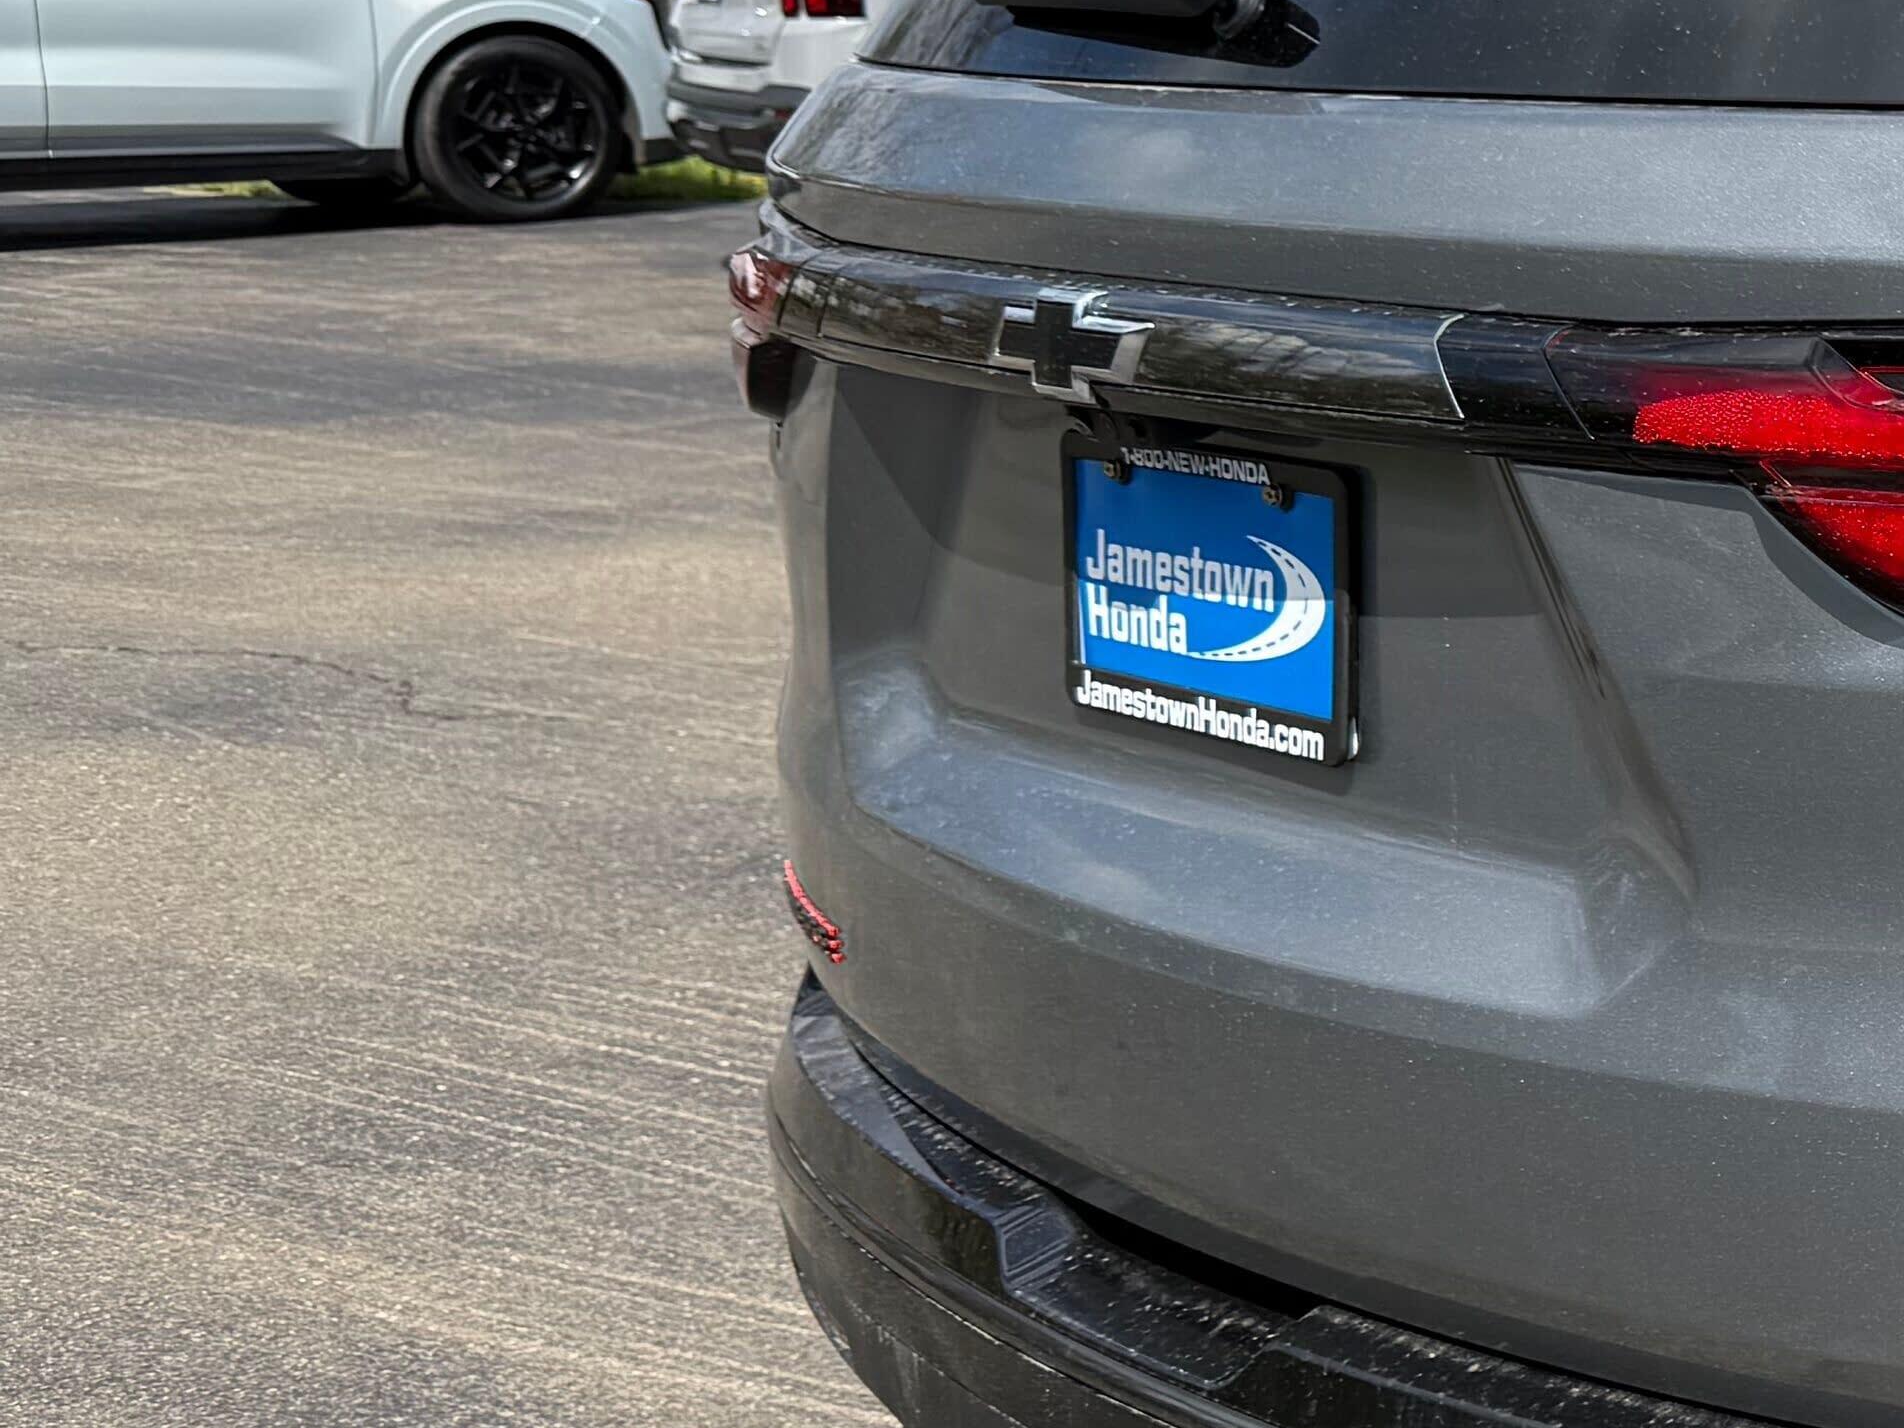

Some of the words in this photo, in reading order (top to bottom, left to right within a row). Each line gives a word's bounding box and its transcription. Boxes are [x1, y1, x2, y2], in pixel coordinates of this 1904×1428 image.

[1121, 446, 1272, 486] 1-800-NEW-HONDA
[1086, 528, 1275, 613] Jamestown
[1086, 582, 1189, 654] Honda
[1076, 669, 1325, 761] JamestownHonda.com
